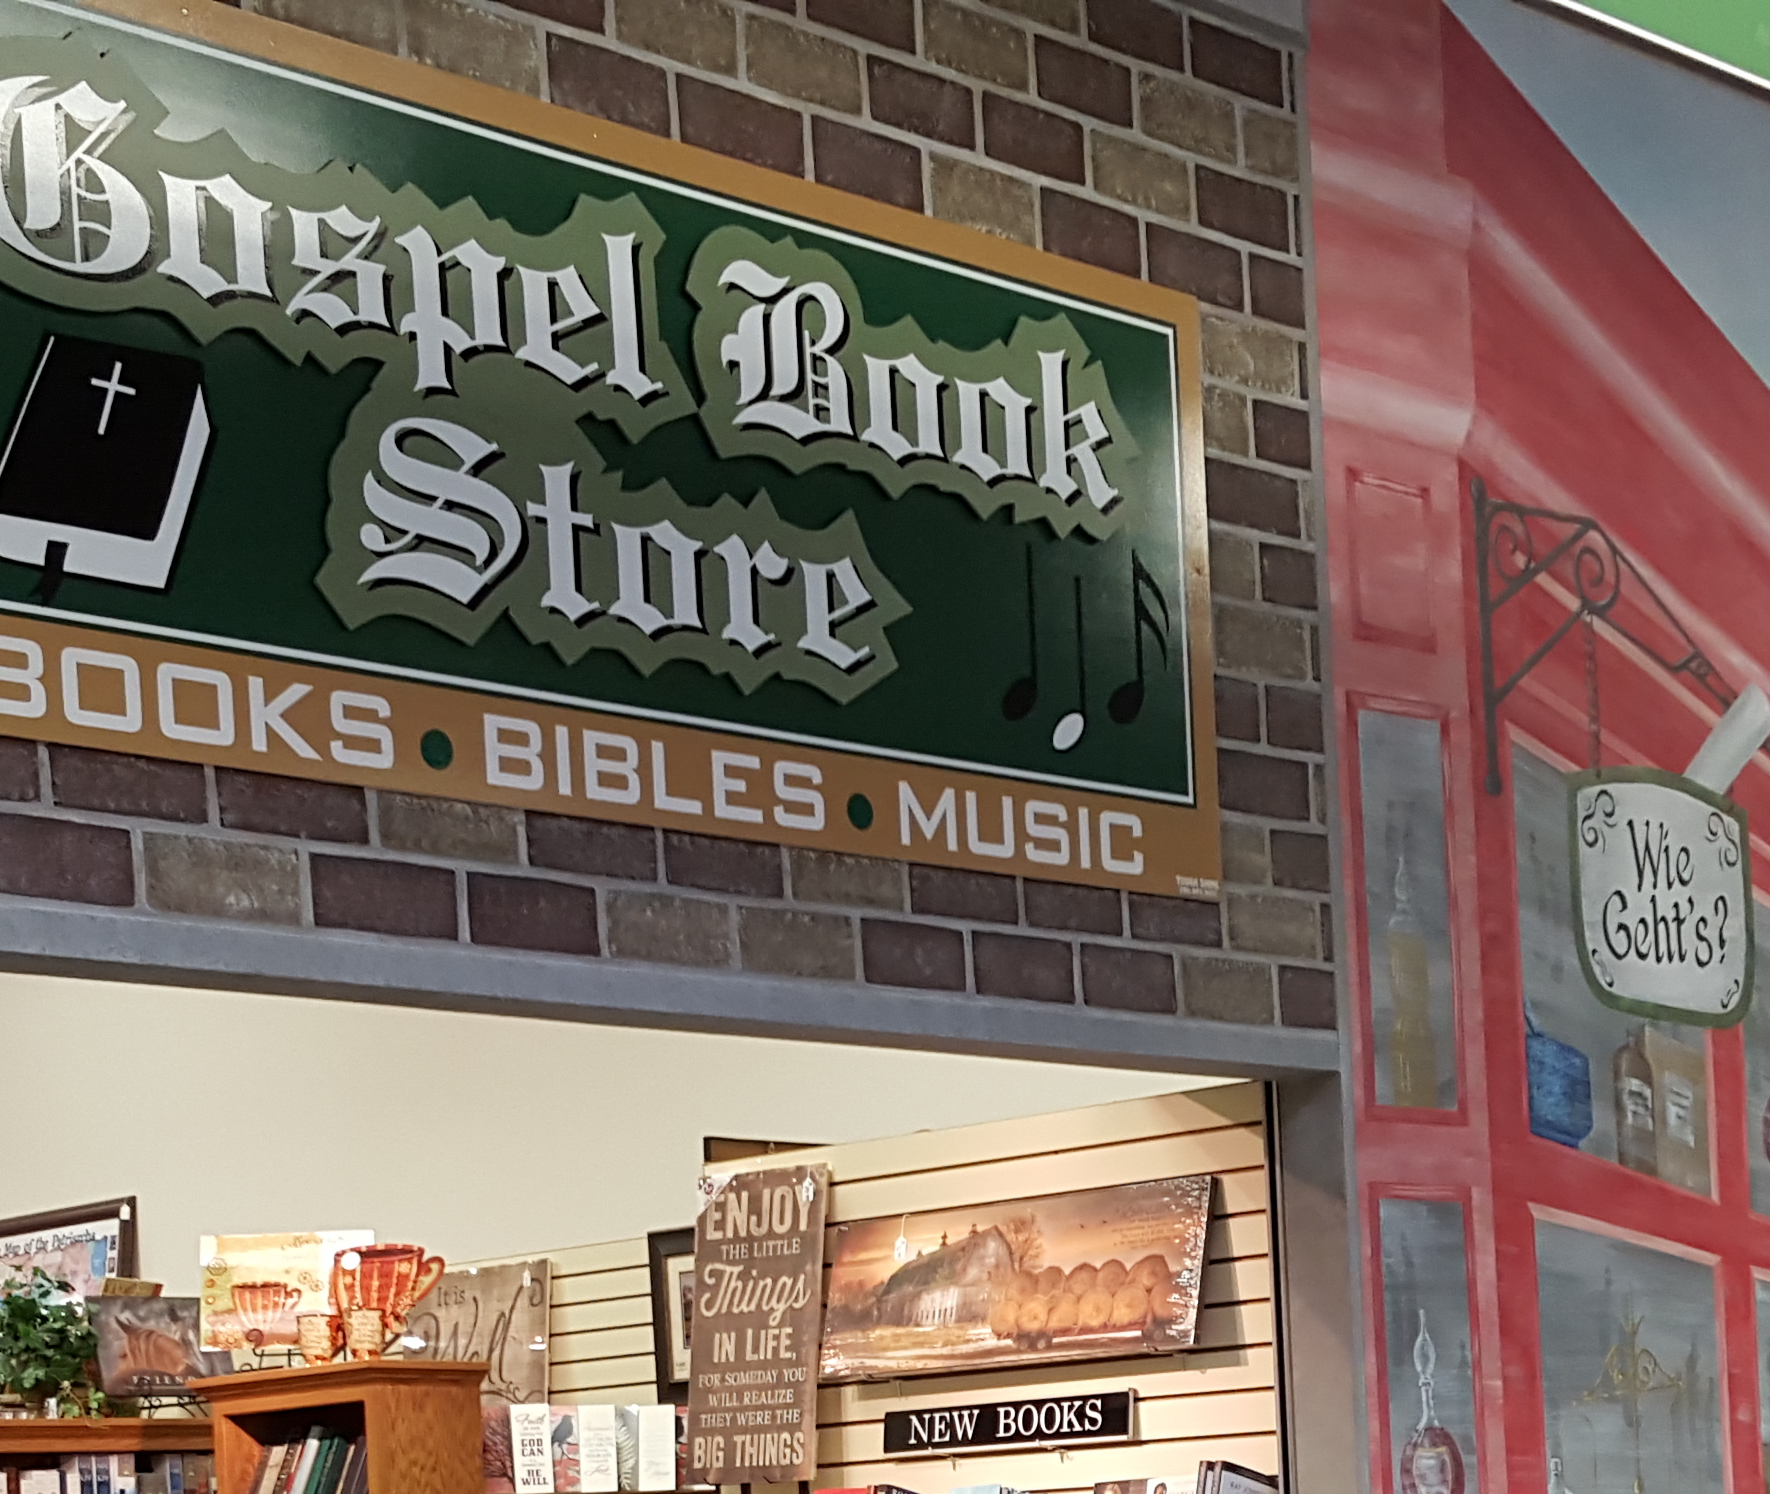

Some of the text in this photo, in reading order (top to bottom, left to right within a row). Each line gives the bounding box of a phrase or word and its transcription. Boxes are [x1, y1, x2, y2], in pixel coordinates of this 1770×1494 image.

[717, 257, 1123, 518] Book
[360, 415, 881, 676] Store
[483, 713, 825, 834] BIBLES
[898, 780, 1146, 879] MUSIC
[1627, 819, 1694, 890] Wie
[1602, 892, 1730, 968] Geht's?
[705, 1184, 812, 1241] ENJOY
[721, 1237, 801, 1261] THE LITTLE
[699, 1262, 812, 1327] Things
[713, 1327, 797, 1363] IN LIFE,
[698, 1366, 807, 1388] FOR SOMEDAY YOU
[708, 1388, 795, 1407] WILL REALIZE
[699, 1408, 802, 1428] THEY WERE THE
[908, 1398, 1104, 1445] NEW BOOKS
[520, 1438, 545, 1449] GOD
[520, 1448, 545, 1458] CAN
[693, 1431, 805, 1470] BIG THINGS
